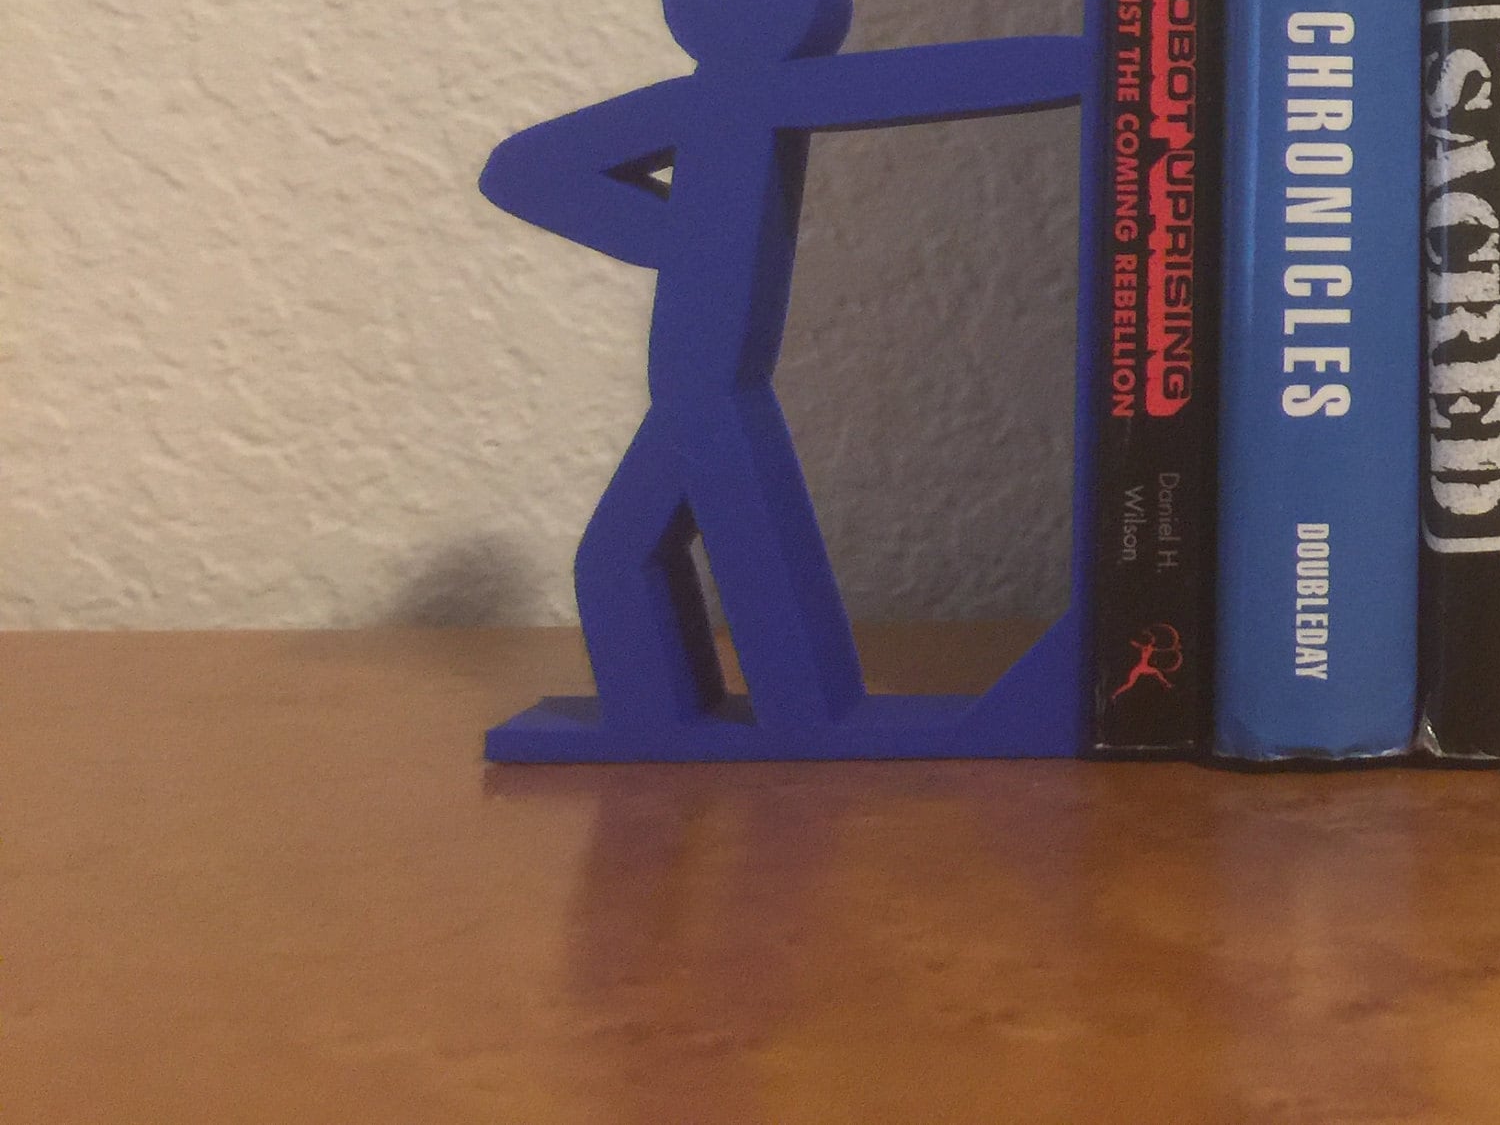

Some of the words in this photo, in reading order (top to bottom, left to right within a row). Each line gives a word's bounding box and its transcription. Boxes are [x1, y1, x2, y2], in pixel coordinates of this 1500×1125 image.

[1115, 47, 1141, 101] THE
[1112, 113, 1139, 241] COMING
[1282, 11, 1355, 419] CHRONICLES
[1110, 254, 1138, 417] REBELLION
[1145, 150, 1195, 417] UPRISING
[1121, 484, 1146, 561] Wilson
[1155, 549, 1179, 574] H.
[1156, 472, 1181, 542] Daniel
[1295, 523, 1329, 681] DOUBLEDAY
